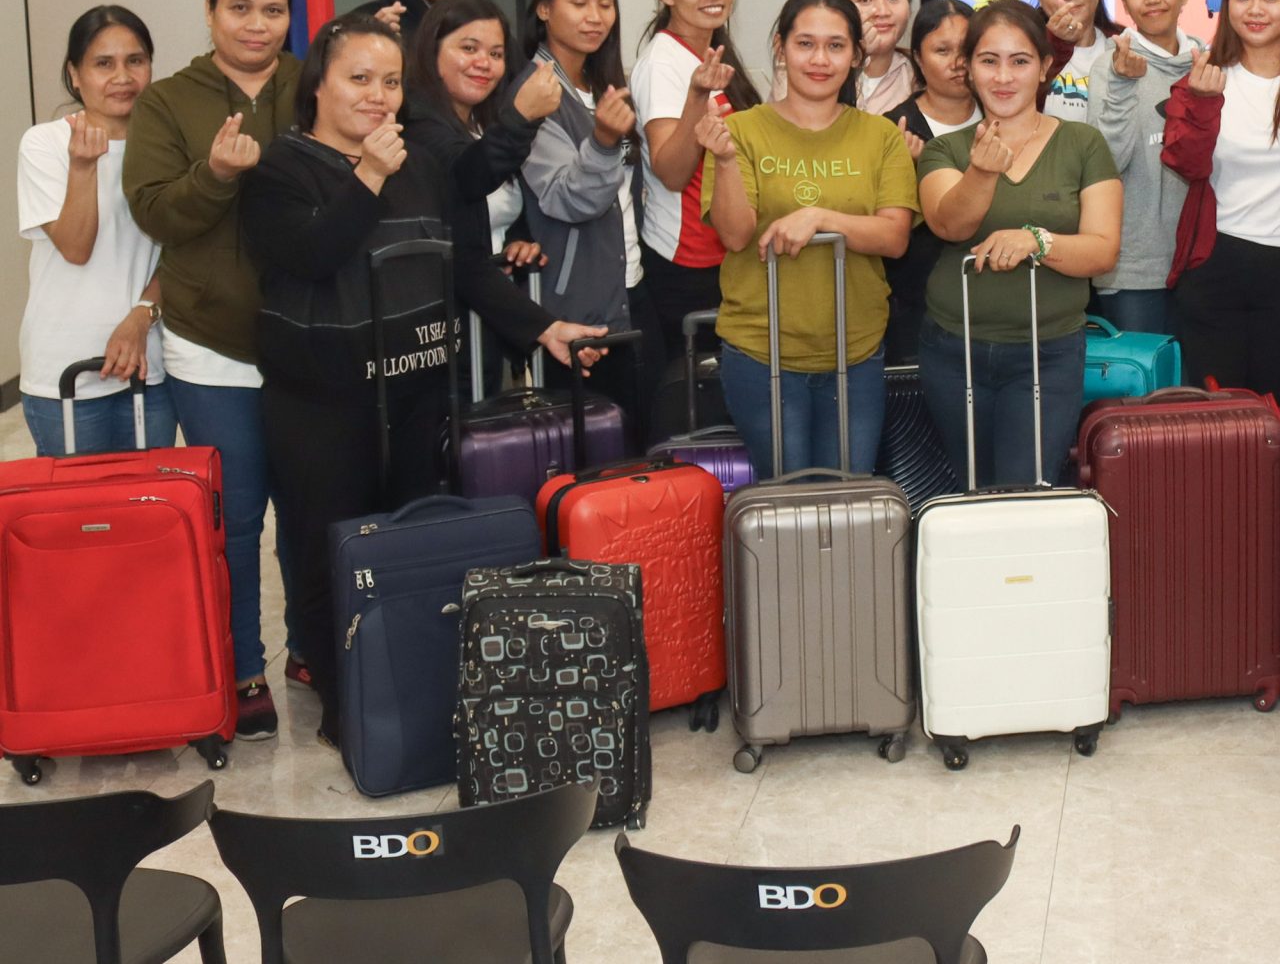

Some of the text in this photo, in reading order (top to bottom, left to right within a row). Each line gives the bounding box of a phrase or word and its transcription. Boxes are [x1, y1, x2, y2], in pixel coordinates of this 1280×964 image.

[760, 156, 861, 178] CHANEL
[352, 830, 440, 859] BDO
[757, 883, 847, 910] BDO
